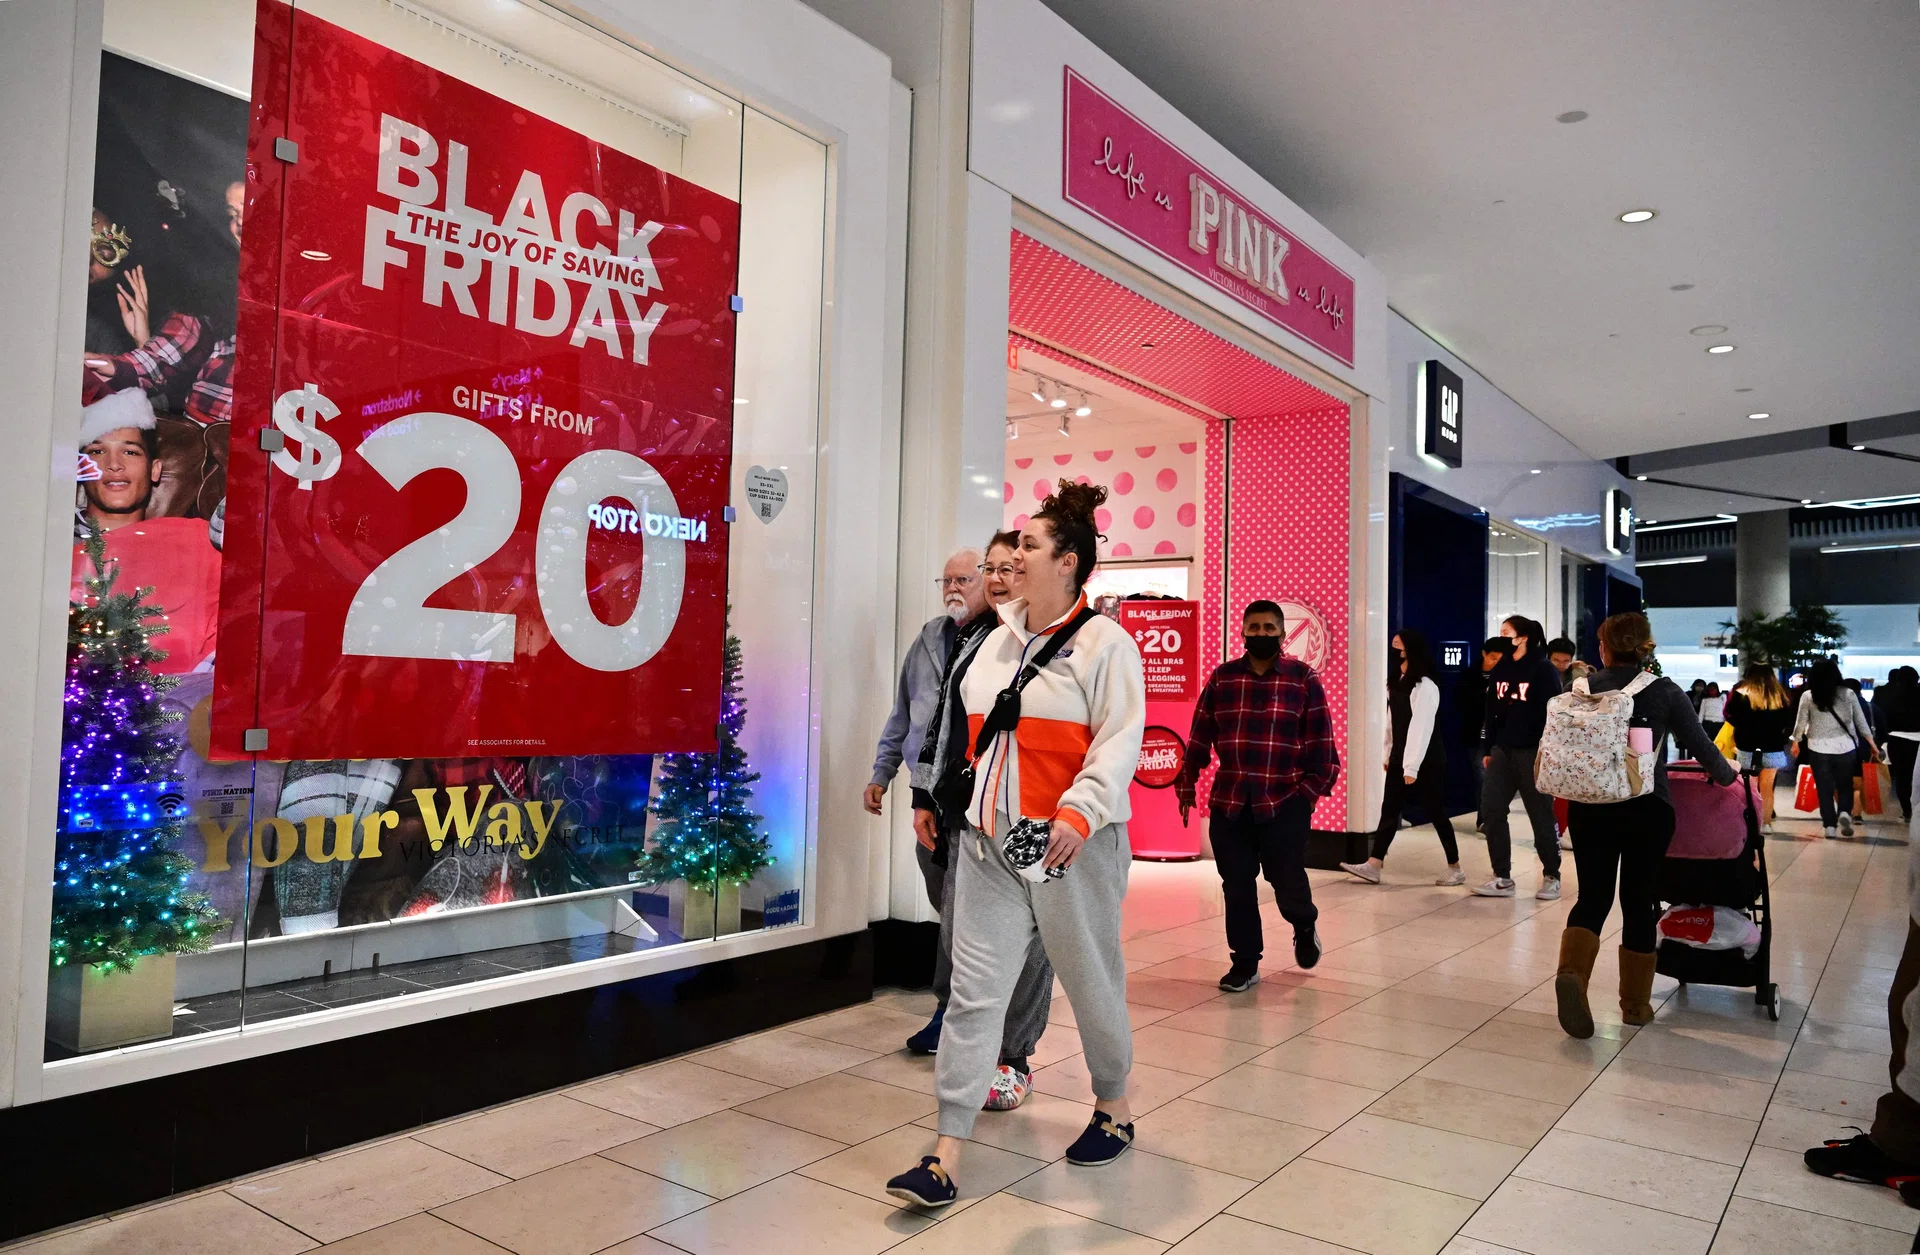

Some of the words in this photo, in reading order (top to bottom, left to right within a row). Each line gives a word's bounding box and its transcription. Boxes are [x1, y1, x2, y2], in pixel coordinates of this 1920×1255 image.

[377, 111, 666, 292] BLACK
[1094, 136, 1147, 200] life
[1155, 190, 1173, 212] is
[1188, 171, 1291, 306] PINK
[406, 210, 463, 244] THE
[467, 226, 519, 262] JOY
[524, 240, 557, 267] OF
[562, 249, 646, 289] SAVING
[361, 205, 669, 366] FRIDAY
[452, 384, 524, 421] GIFTS
[530, 400, 594, 437] FROM
[1441, 385, 1458, 428] GAP
[1128, 610, 1158, 618] BLACK
[1160, 610, 1192, 618] FRIDAY
[1135, 630, 1181, 653] $20
[1444, 652, 1462, 665] GAP
[1137, 759, 1178, 770] FRIDAY
[197, 808, 400, 872] Your
[411, 783, 564, 861] Way
[400, 831, 539, 862] VICTORIA'S
[550, 824, 624, 848] SECRET
